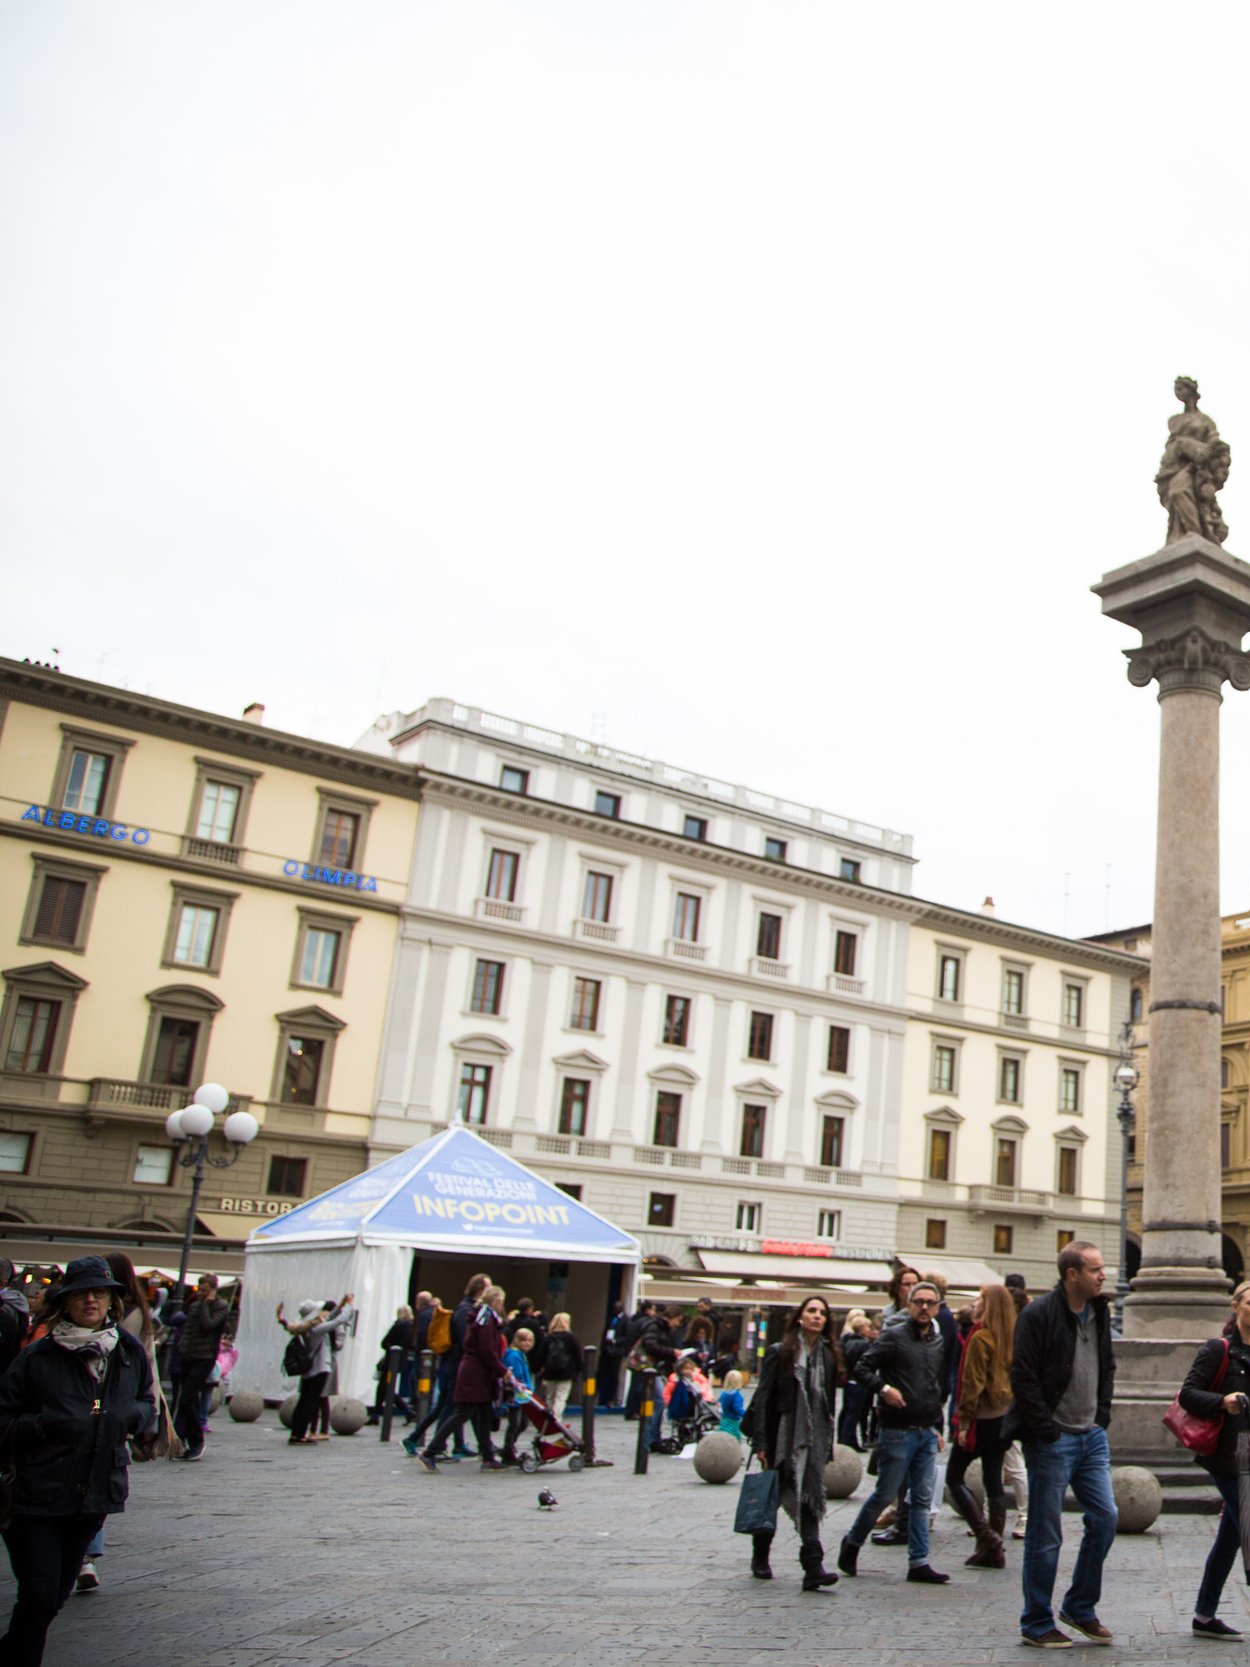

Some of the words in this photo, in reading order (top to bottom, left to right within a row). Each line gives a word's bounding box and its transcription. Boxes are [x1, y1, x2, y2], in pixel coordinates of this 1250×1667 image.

[21, 804, 151, 846] ALBERGO
[283, 859, 379, 893] OLIMPIA
[427, 1172, 489, 1188] FESTIVAL
[494, 1177, 537, 1192] DELLE
[435, 1184, 537, 1201] GENERAZIONI
[220, 1198, 298, 1214] RISTOR
[413, 1194, 570, 1225] INFOPOINT
